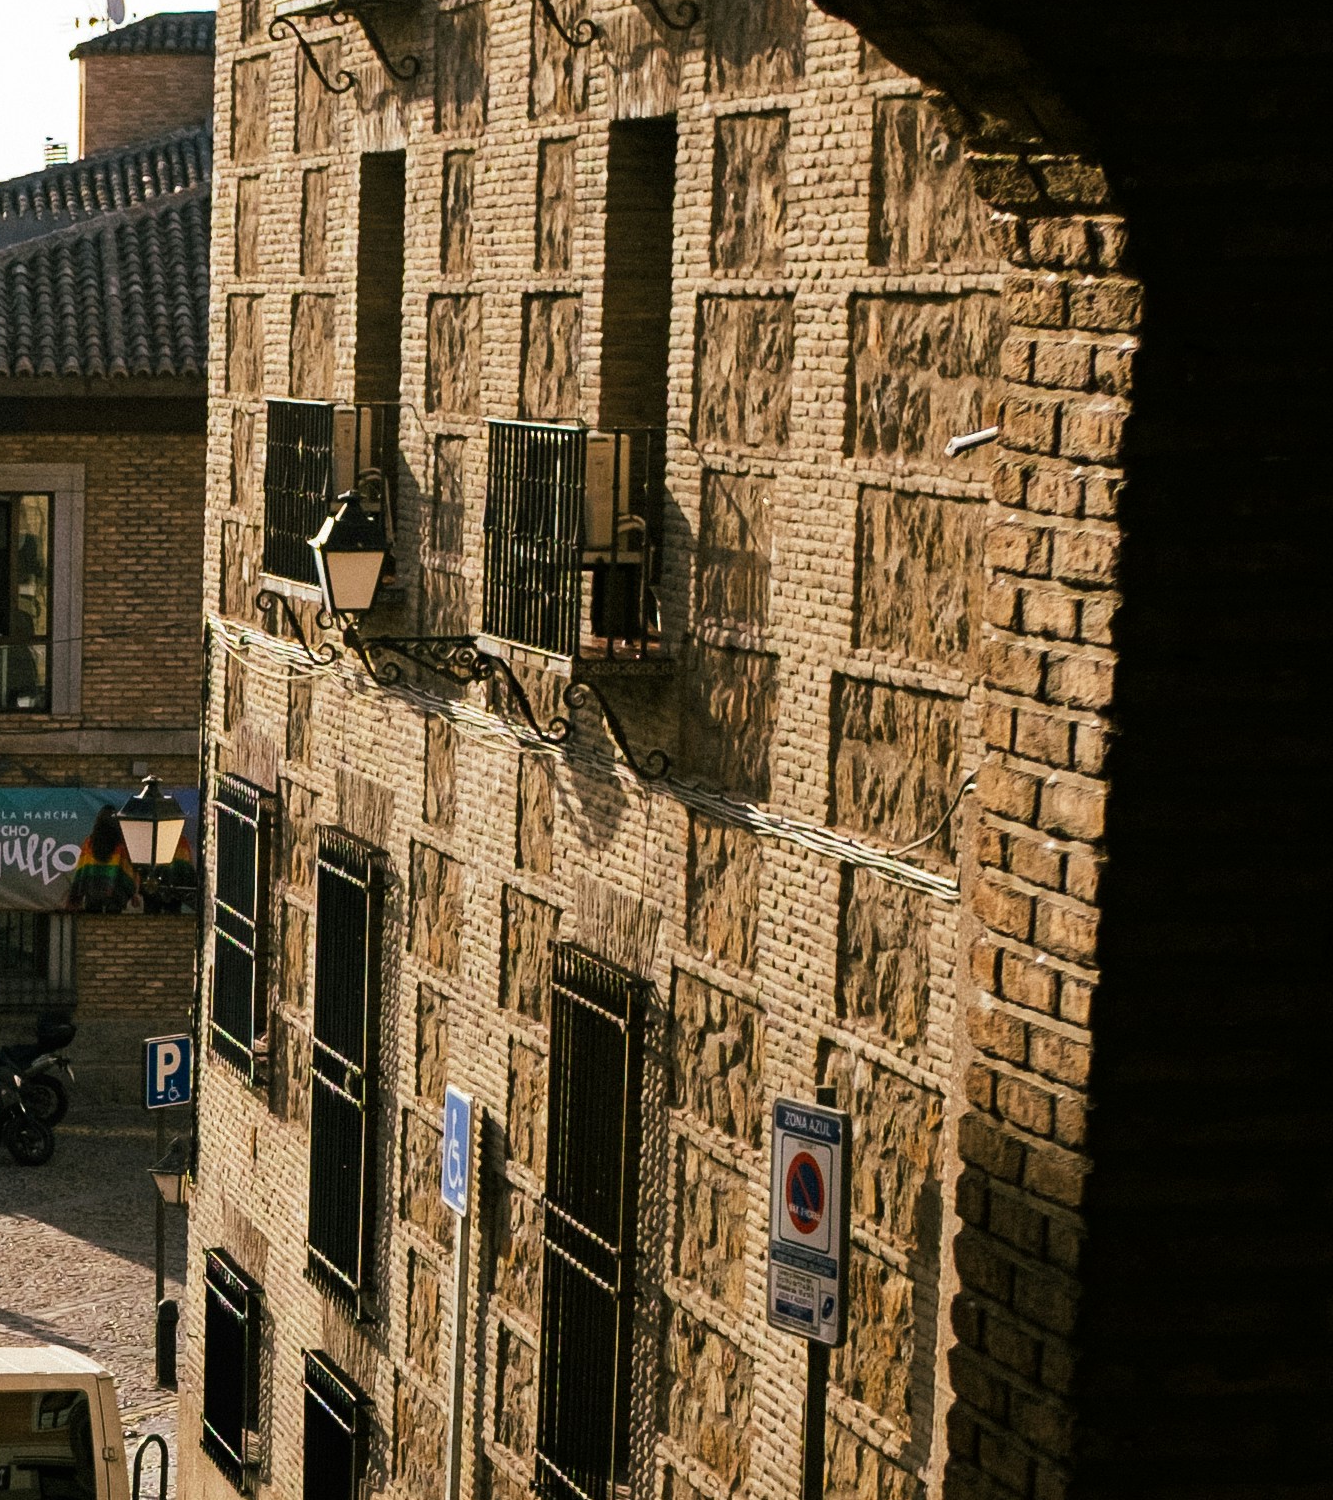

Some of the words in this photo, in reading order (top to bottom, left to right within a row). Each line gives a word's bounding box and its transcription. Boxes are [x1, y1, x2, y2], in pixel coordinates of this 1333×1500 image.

[23, 810, 78, 820] MANCHA
[156, 1043, 181, 1092] P
[784, 1111, 808, 1131] ZONA
[809, 1118, 832, 1138] AZUL
